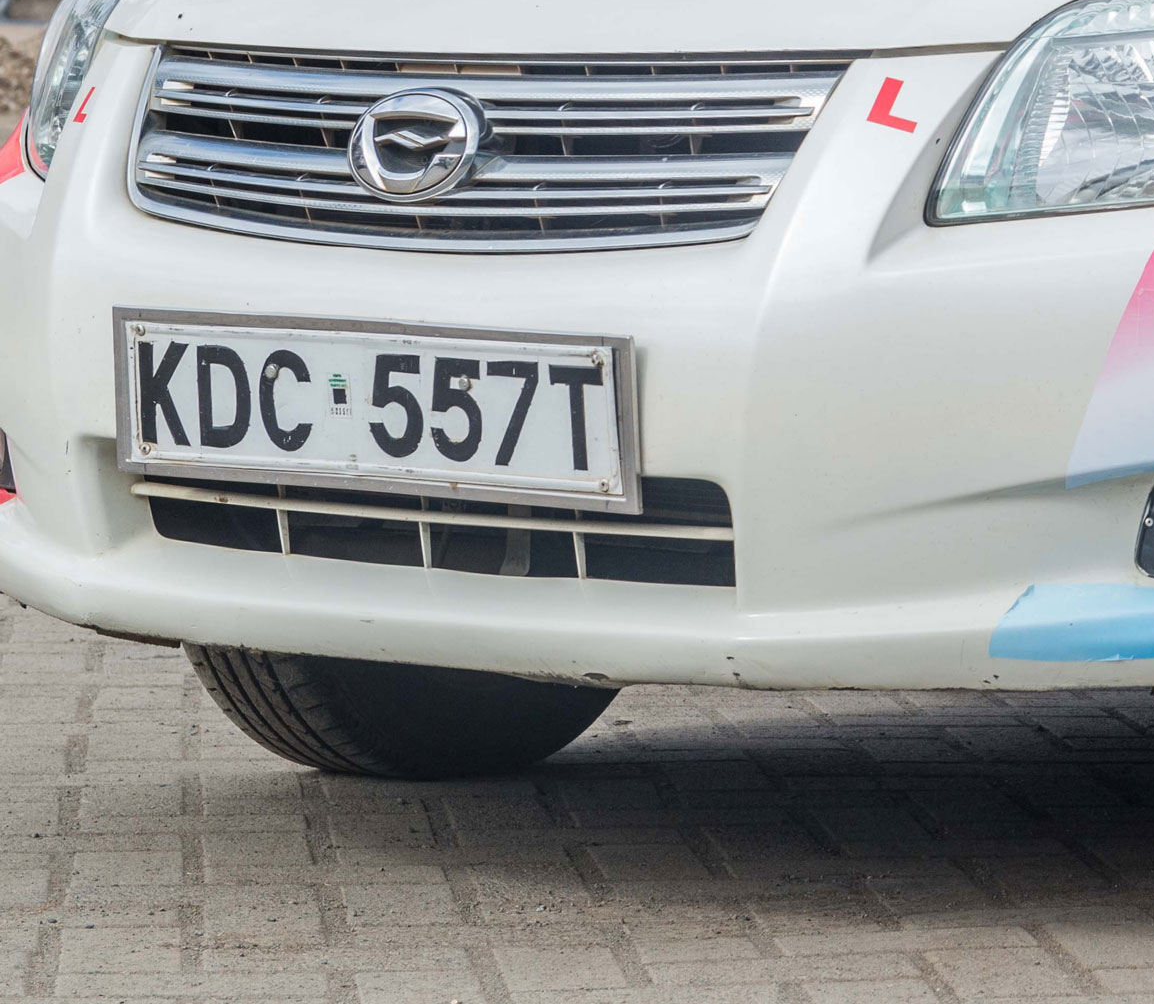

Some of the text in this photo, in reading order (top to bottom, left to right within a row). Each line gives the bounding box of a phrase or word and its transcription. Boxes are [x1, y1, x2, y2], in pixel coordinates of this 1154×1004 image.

[73, 86, 96, 123] L
[866, 76, 917, 133] L
[137, 341, 604, 471] KDC 557T
